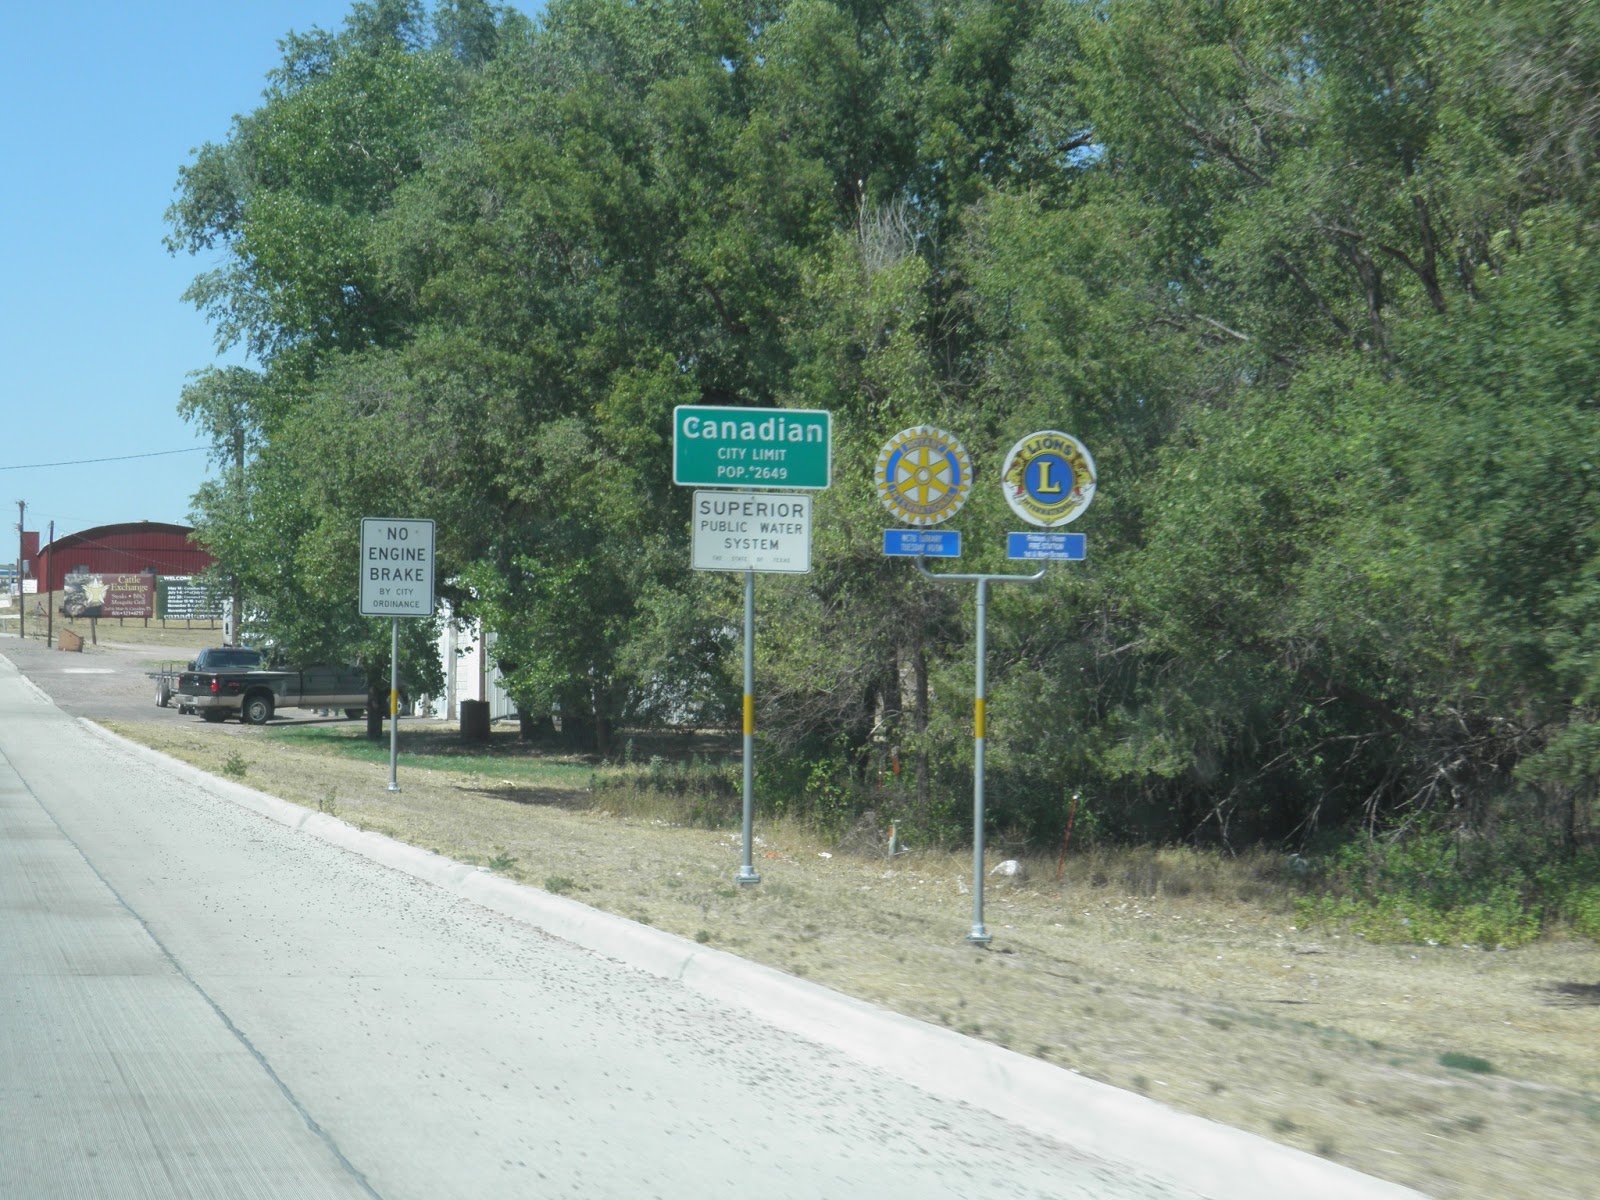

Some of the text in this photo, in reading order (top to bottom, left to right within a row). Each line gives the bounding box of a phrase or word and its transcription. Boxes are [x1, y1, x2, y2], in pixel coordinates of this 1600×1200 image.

[682, 416, 823, 443] Canadian
[1027, 437, 1073, 456] LIONS
[717, 448, 787, 461] CITY LIMIT
[717, 466, 788, 480] POP. 2649
[1036, 461, 1061, 494] L
[699, 500, 804, 518] SUPERIOR
[387, 527, 408, 541] NO
[700, 520, 803, 535] PUBLIC WATER
[724, 538, 779, 550] SYSTEM
[369, 547, 426, 562] ENGINE
[118, 575, 141, 584] Cattle
[370, 567, 424, 582] BRAKE
[110, 583, 149, 593] Exchange
[379, 587, 414, 596] BY CITY
[372, 600, 420, 608] ORDINANCE
